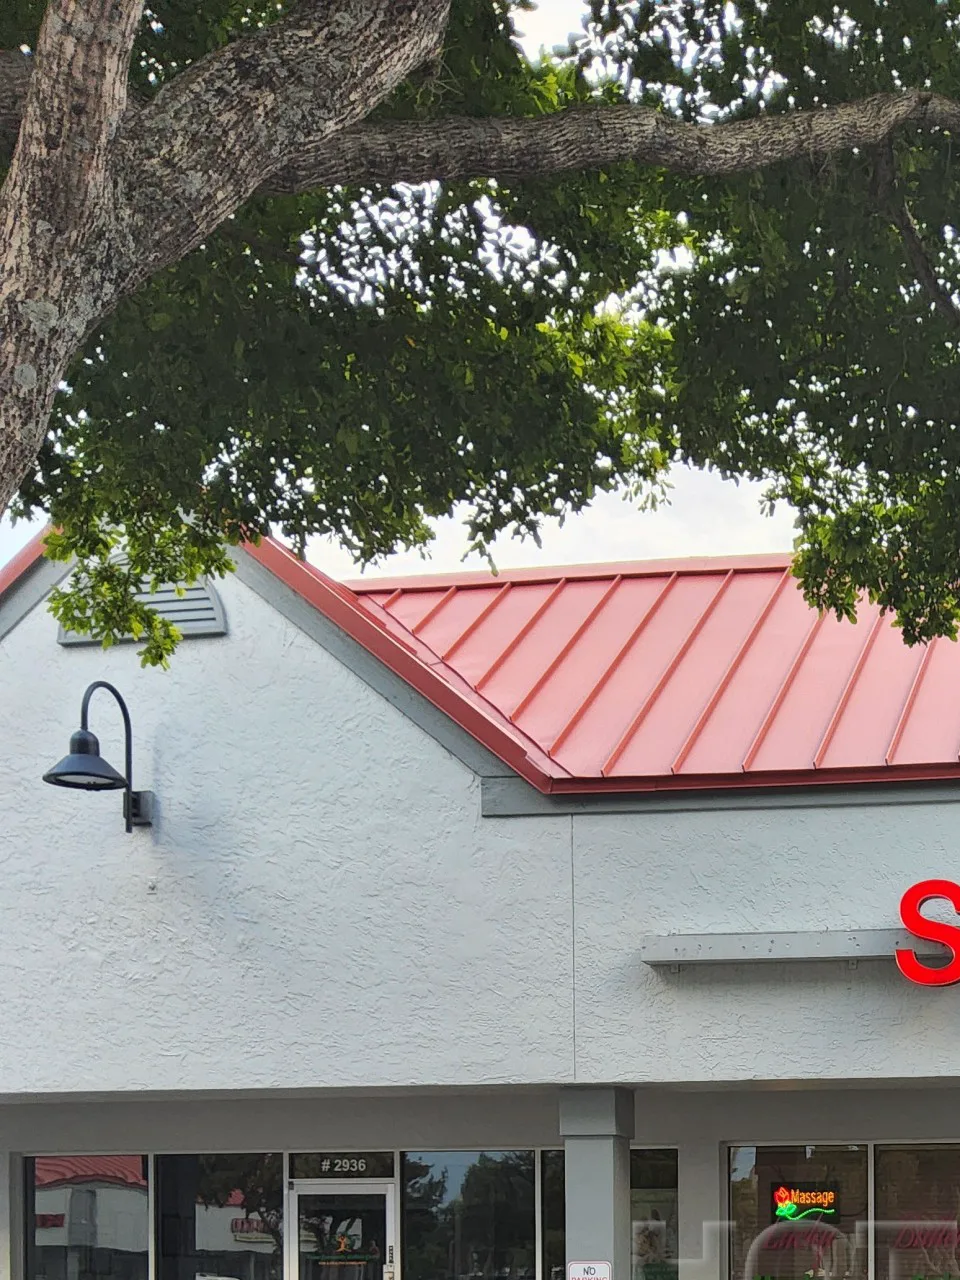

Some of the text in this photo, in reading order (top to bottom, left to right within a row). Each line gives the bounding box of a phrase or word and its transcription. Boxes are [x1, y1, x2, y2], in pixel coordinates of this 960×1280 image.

[334, 1158, 367, 1173] 2936
[790, 1189, 835, 1207] Massage
[583, 1266, 596, 1276] NO
